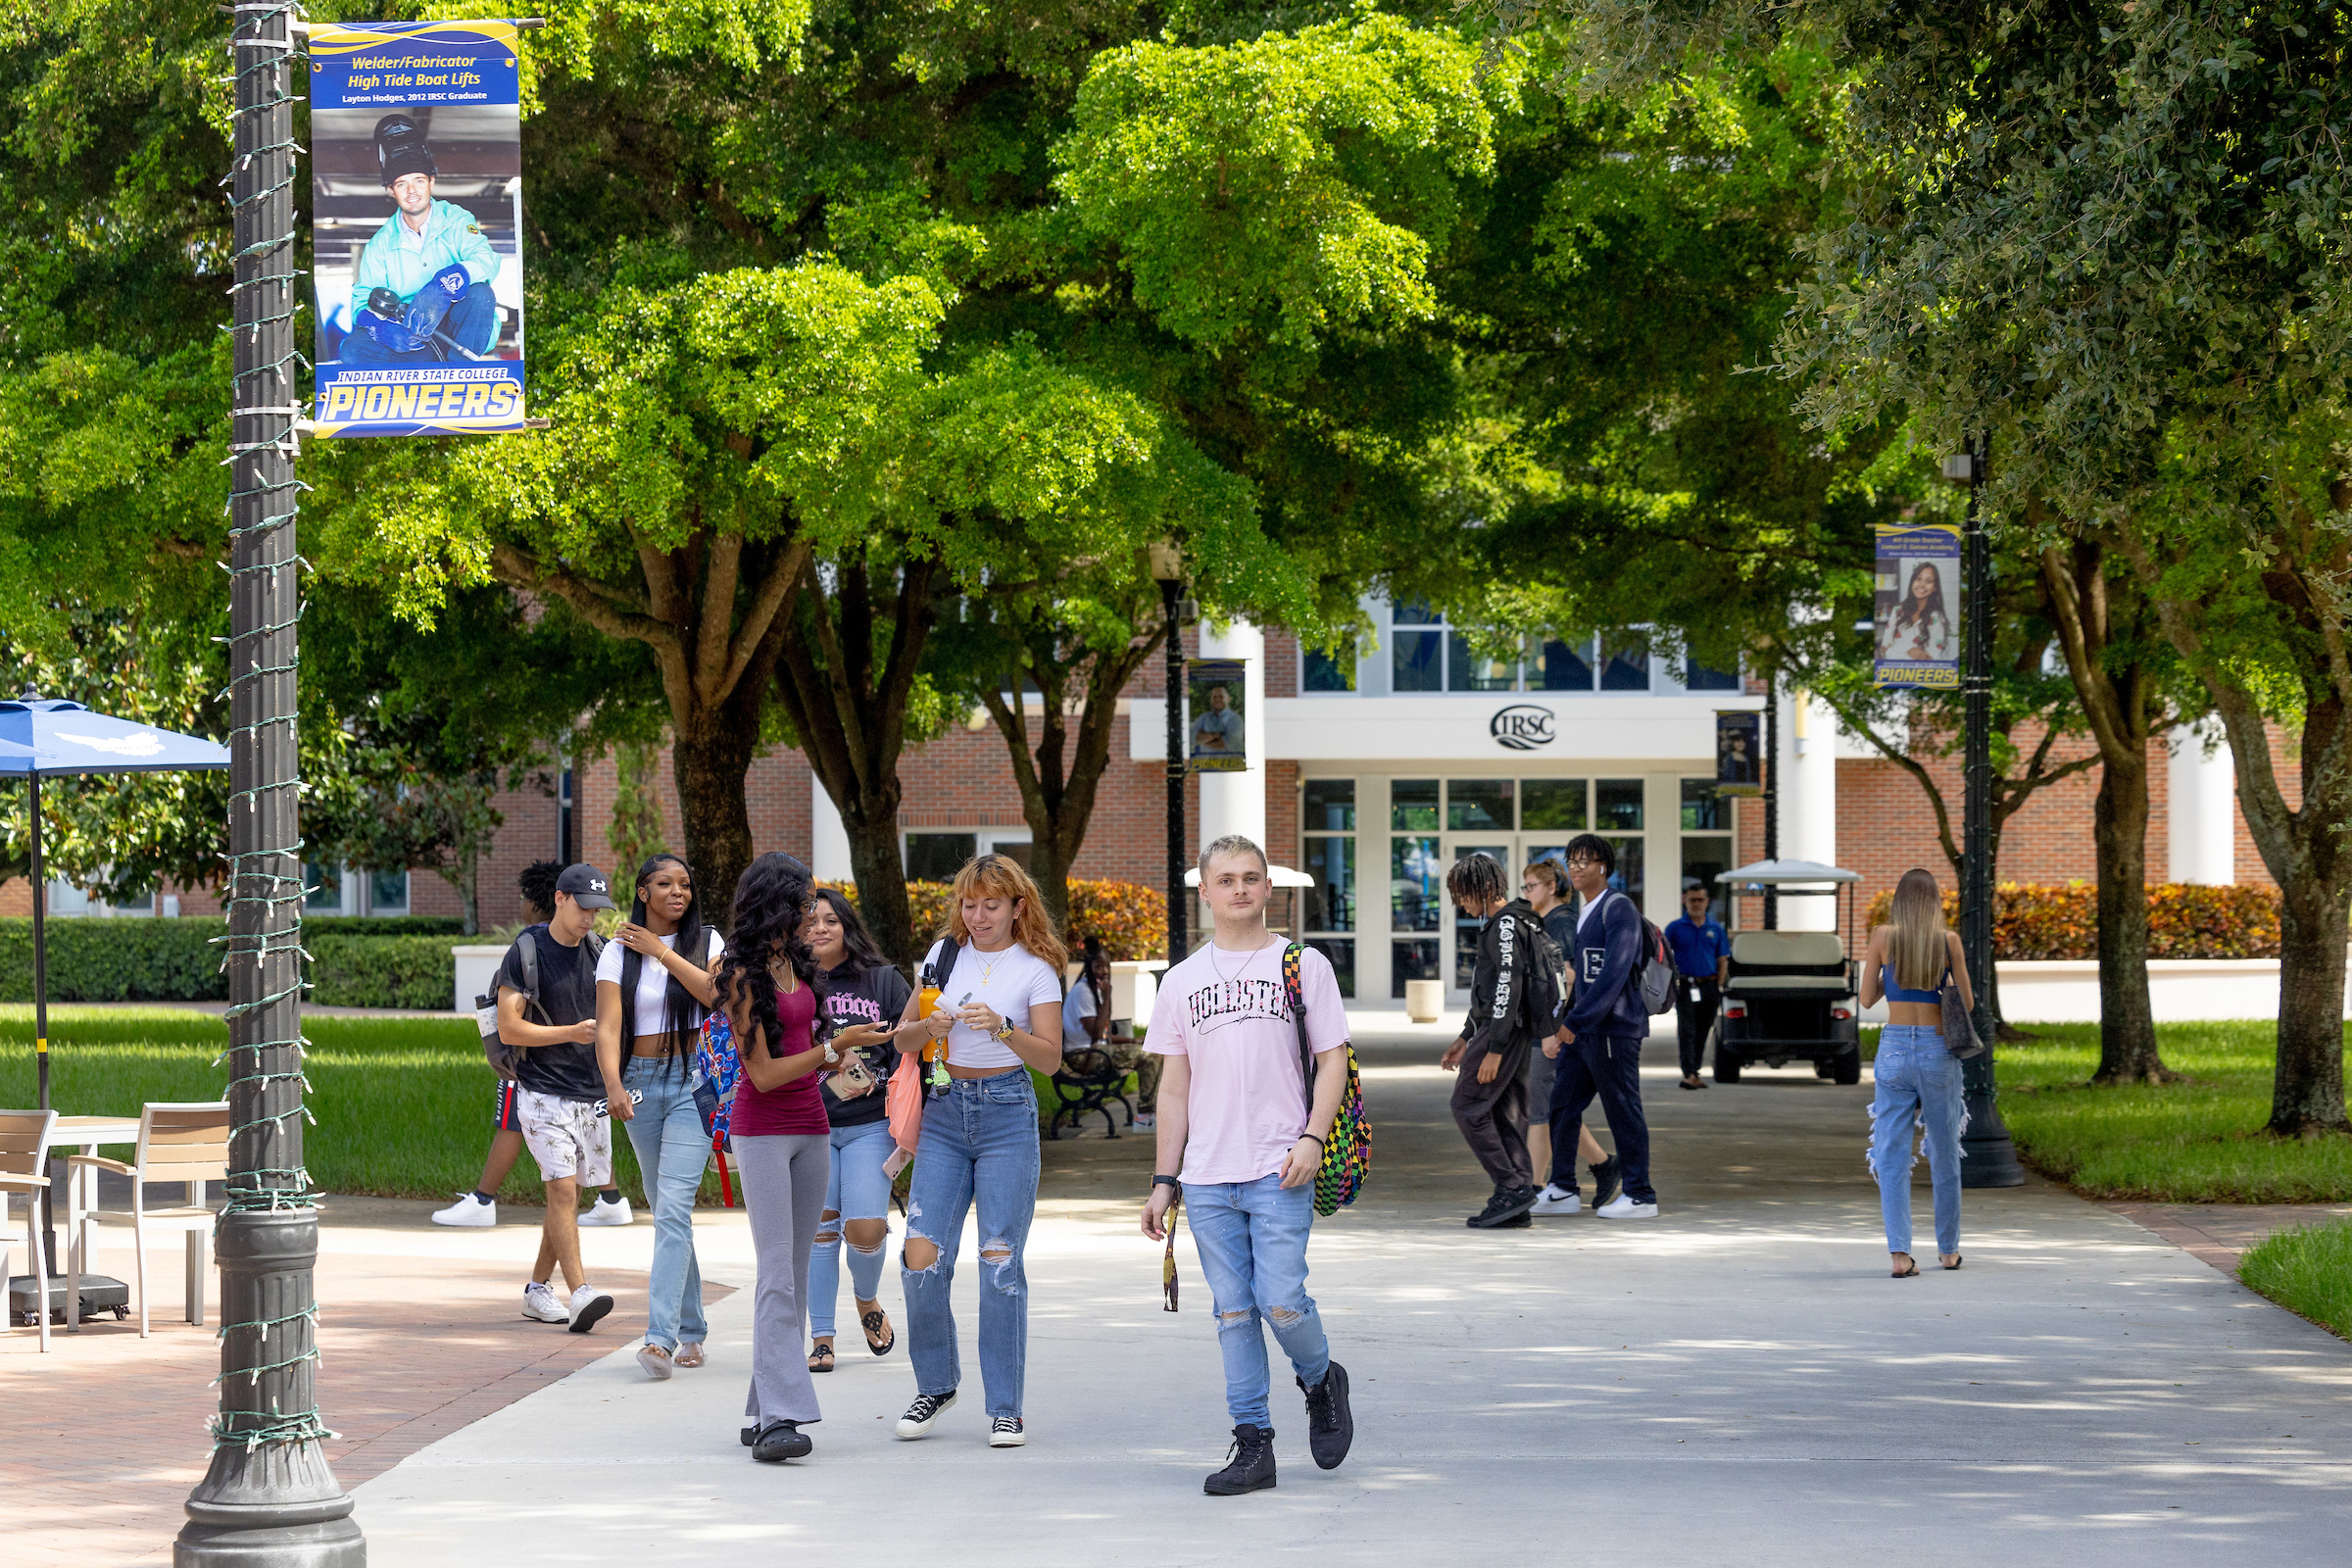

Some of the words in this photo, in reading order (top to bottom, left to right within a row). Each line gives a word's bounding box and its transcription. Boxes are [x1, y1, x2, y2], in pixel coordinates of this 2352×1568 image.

[352, 55, 477, 71] Welder/Fabricator
[348, 74, 380, 91] High
[383, 74, 413, 88] Tide
[416, 73, 448, 86] Boat
[451, 72, 481, 88] Lifts
[342, 95, 371, 104] Layton
[372, 94, 407, 103] Hodges,
[448, 91, 488, 100] Graduate
[339, 371, 382, 382] INDIAN
[386, 370, 419, 382] RIVER
[422, 369, 455, 381] STATE
[457, 368, 508, 380] COLLEGE
[325, 382, 517, 421] PIONEERS
[1879, 667, 1955, 682] PIONEERS
[1188, 979, 1291, 1028] HOLLISTER
